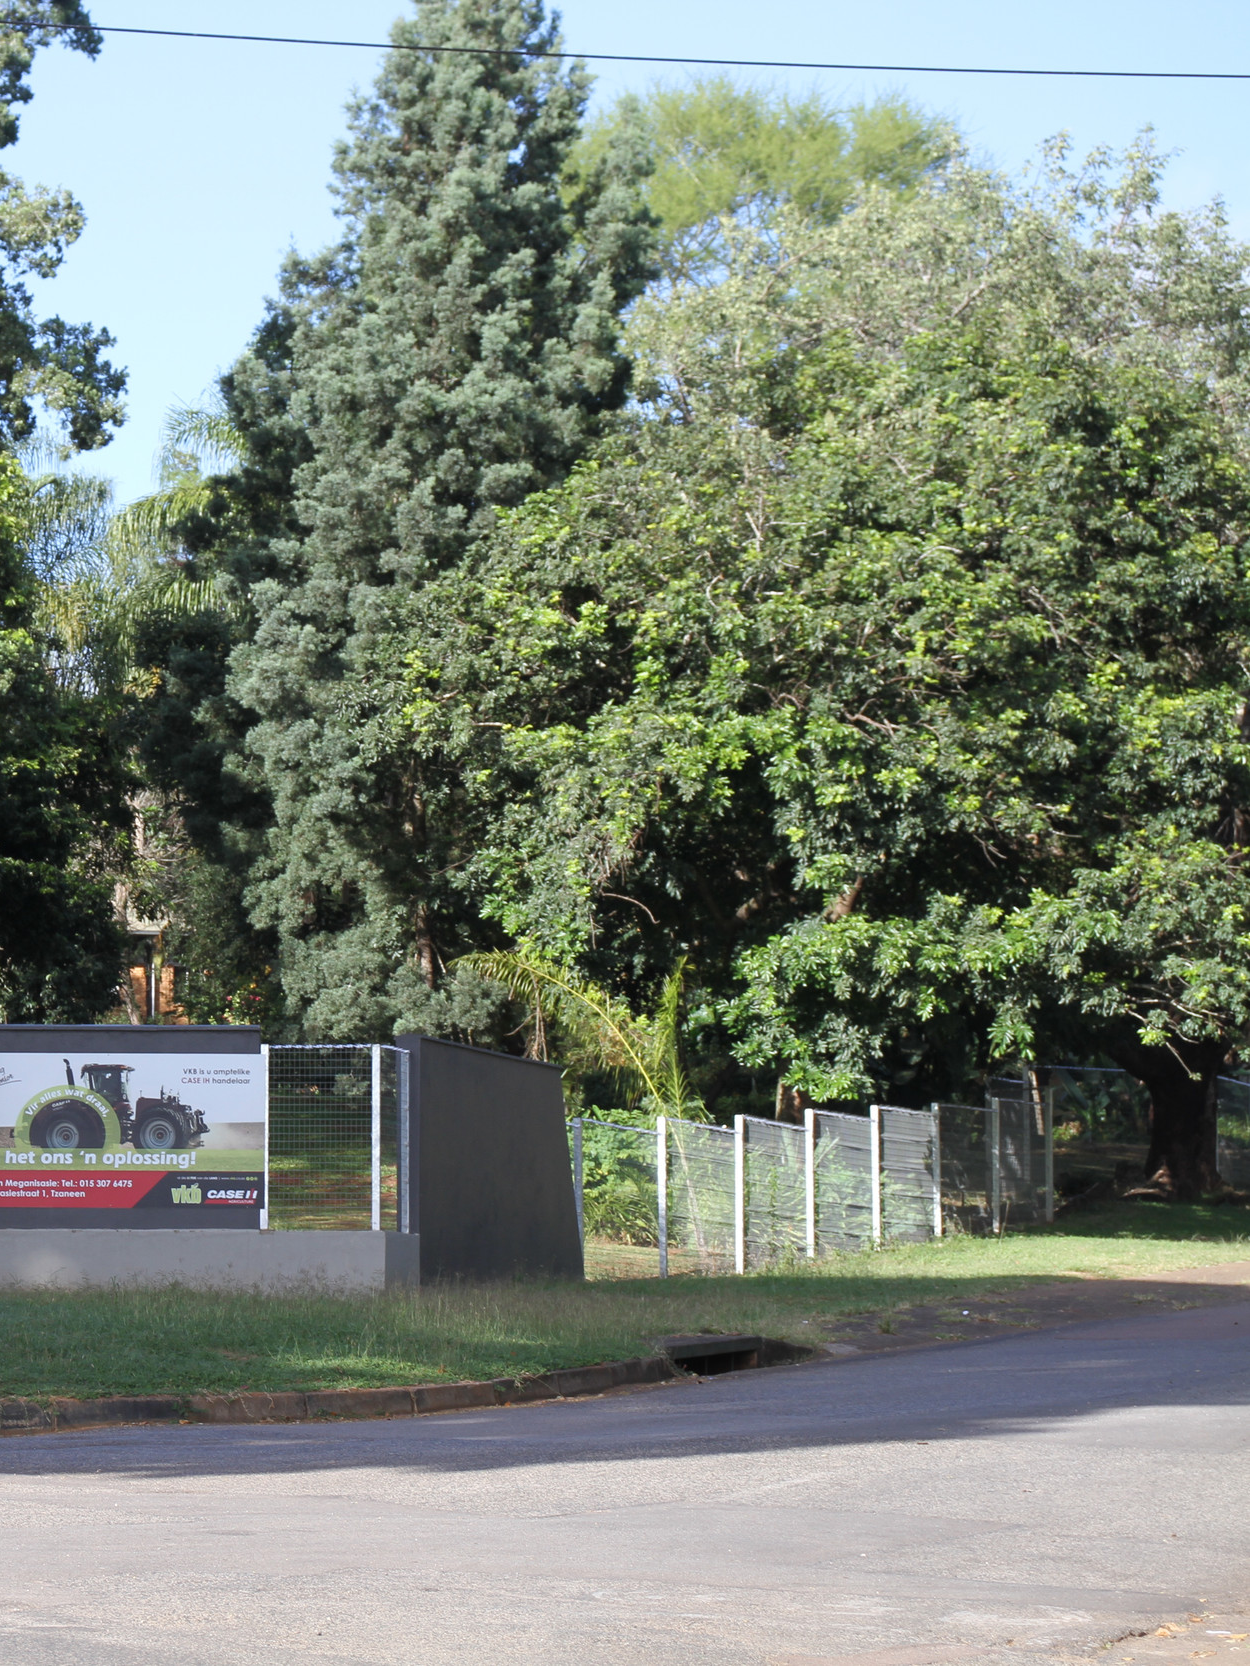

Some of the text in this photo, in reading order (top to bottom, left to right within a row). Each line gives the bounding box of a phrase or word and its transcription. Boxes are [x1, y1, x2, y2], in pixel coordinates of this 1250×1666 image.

[213, 1068, 250, 1076] amptelike
[40, 1089, 62, 1104] alles
[64, 1089, 84, 1098] wat
[5, 1150, 35, 1164] het
[40, 1153, 73, 1164] ons
[102, 1151, 196, 1169] oplossing!
[5, 1179, 60, 1188] Meganisasie:
[79, 1179, 94, 1187] 015
[112, 1180, 133, 1188] 6475
[51, 1190, 86, 1198] Tzaneen
[171, 1183, 202, 1204] vkb
[207, 1189, 245, 1199] CASE
